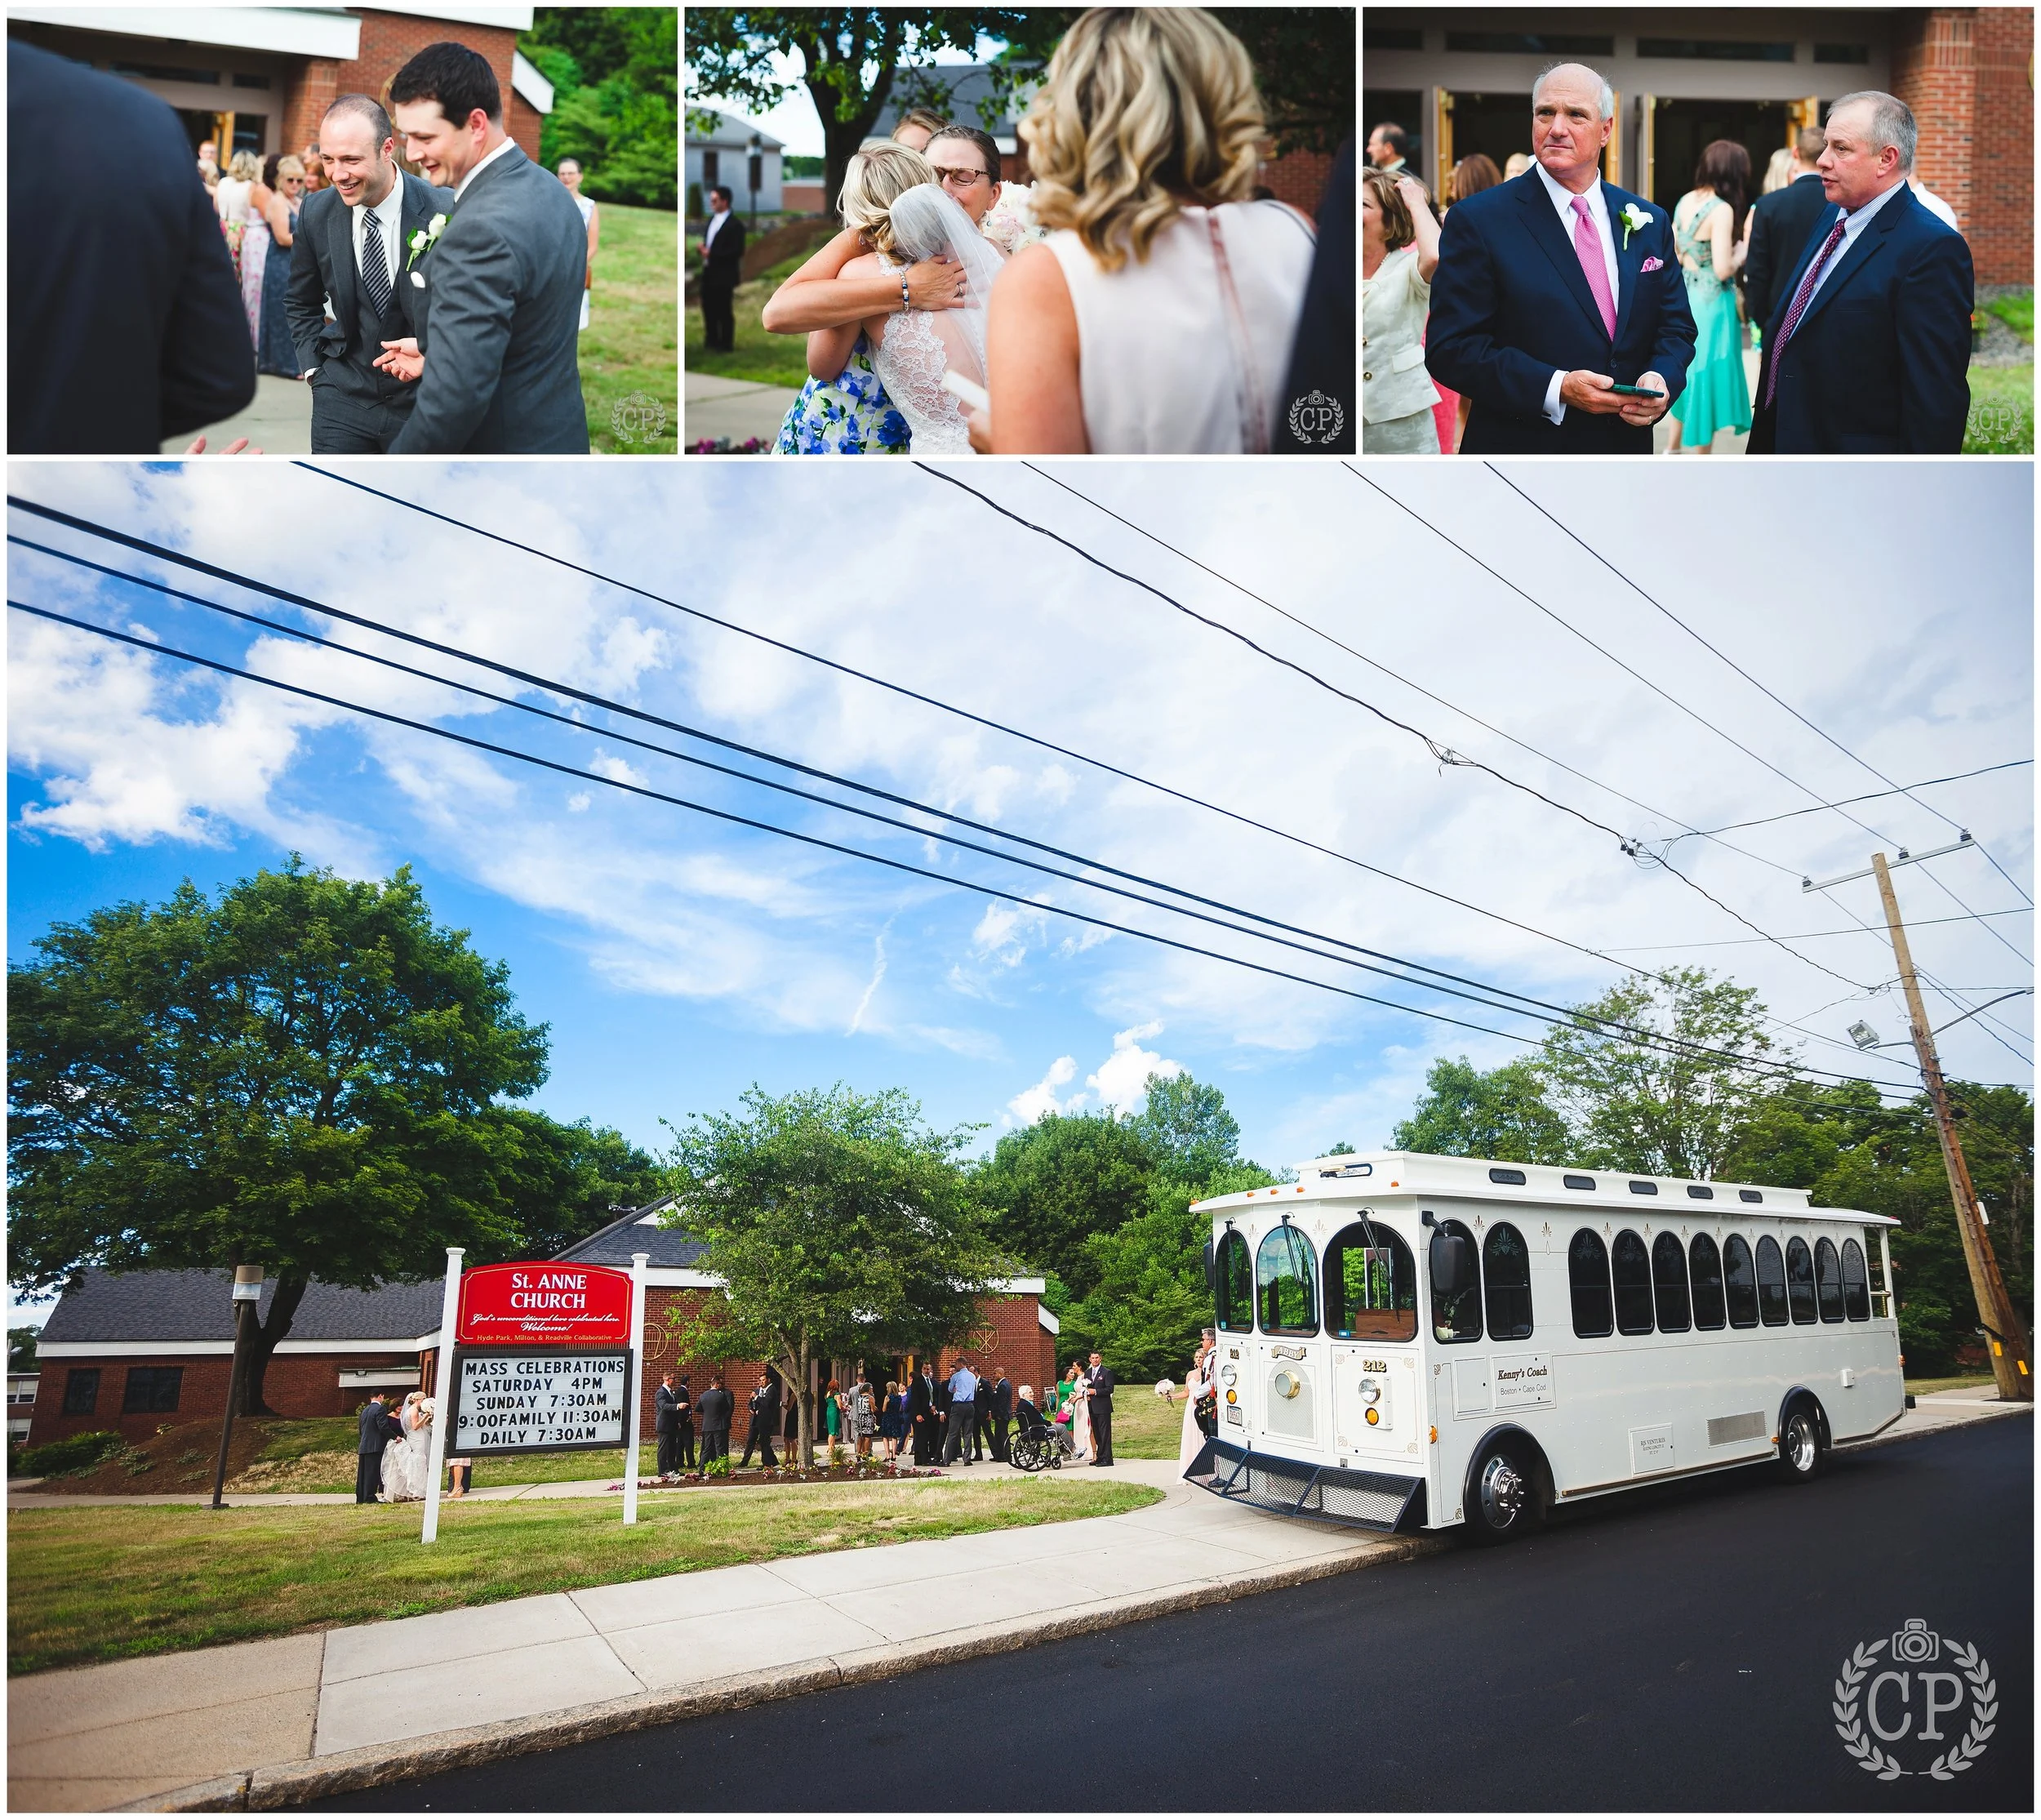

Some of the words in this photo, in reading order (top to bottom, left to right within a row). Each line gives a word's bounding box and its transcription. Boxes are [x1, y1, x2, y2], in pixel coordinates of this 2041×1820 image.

[512, 1273, 533, 1288] St.
[537, 1273, 587, 1289] ANNE
[510, 1293, 586, 1309] CHURCH
[470, 1313, 496, 1326] God's
[496, 1314, 552, 1322] unconditional
[568, 1313, 606, 1322] celebrated
[520, 1321, 573, 1332] Welcome!
[477, 1334, 495, 1342] Hyde
[1277, 1346, 1300, 1359] ABBY
[465, 1362, 508, 1376] MASS
[516, 1360, 625, 1374] CELEBRATIONS
[1363, 1359, 1387, 1373] 212
[1497, 1368, 1525, 1382] Kenny's
[1527, 1364, 1548, 1377] Coach
[472, 1377, 554, 1393] SATURDAY
[571, 1377, 603, 1390] 4PM
[1500, 1387, 1518, 1395] Boston
[1522, 1385, 1536, 1394] Cape
[1536, 1383, 1546, 1391] Cod
[476, 1395, 537, 1410] SUNDAY
[550, 1393, 607, 1407] 7:30AM
[562, 1408, 621, 1424] 11:30AM
[480, 1430, 527, 1445] DAILY
[538, 1426, 597, 1442] 7:30AM
